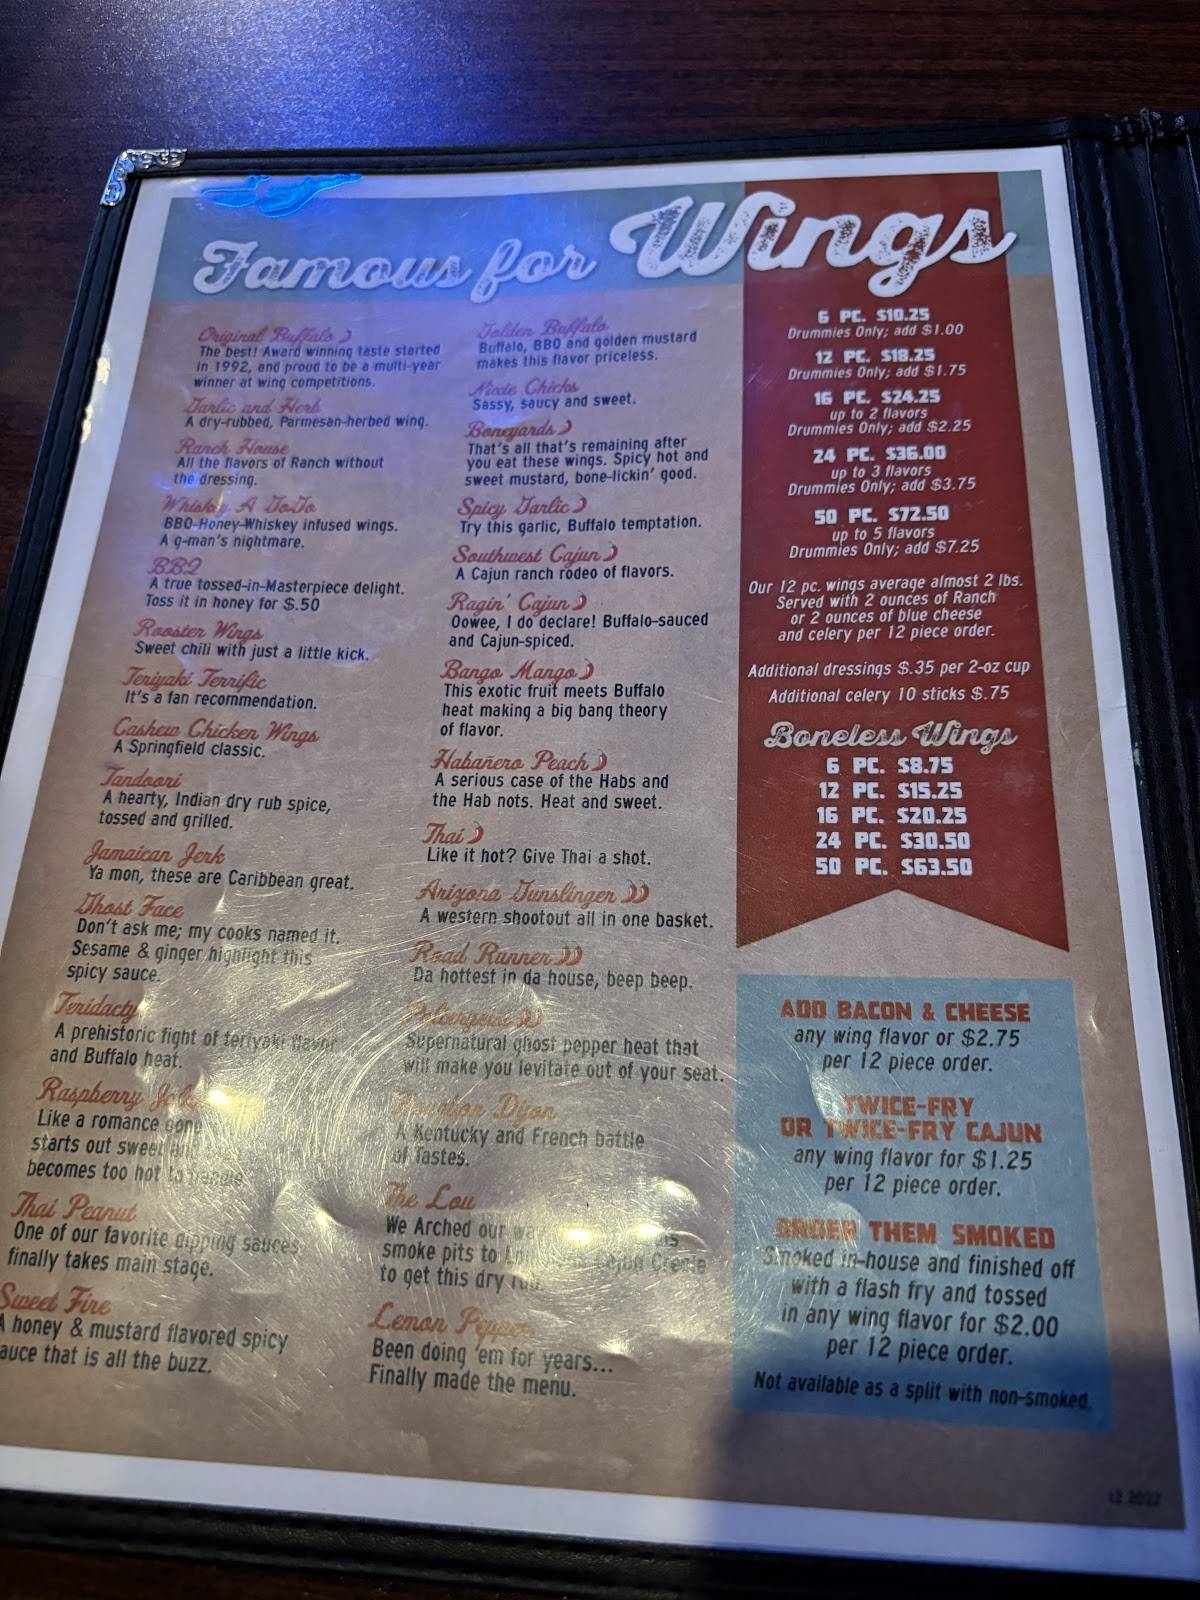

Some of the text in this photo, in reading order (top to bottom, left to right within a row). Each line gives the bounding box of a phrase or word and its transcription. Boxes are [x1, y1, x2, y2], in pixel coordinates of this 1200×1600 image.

[193, 190, 1016, 303] Famous for Wings
[817, 308, 930, 324] 6 PC. $10.25
[787, 324, 964, 340] Drummies Only; add $1.00
[815, 348, 935, 364] 12 PC. $18.25
[787, 364, 967, 382] Drummies Only; add $1.75
[814, 390, 940, 405] 16 PC. $24.25
[184, 415, 427, 432] A dry-rubbed, Parmesan-herbed wing.
[829, 407, 928, 423] up to 2 flavors
[787, 420, 972, 438] Drummies Only; add $2.25
[812, 446, 946, 464] 24 PC. $36.00
[830, 465, 932, 482] up to 3 flavors
[814, 506, 949, 525] 50 PC. $72.50
[460, 516, 701, 536] Try this garlic, Buffalo temptation.
[453, 544, 600, 567] Southwest Cajun
[455, 564, 673, 584] A Cajun ranch rodeo of flavors.
[747, 575, 1022, 597] Our 12 pc. wings average almost 2 lbs.
[775, 591, 997, 610] Served with 2 ounces of Ranch
[133, 642, 368, 662] Sweet chili with just a little kick.
[121, 666, 266, 694] Teriyaki Terrific
[440, 659, 577, 684] Bango Mango
[747, 660, 1030, 681] Additional dressings $.35 per 2-oz cup
[444, 683, 665, 697] This exotic fruit meets Buffalo
[124, 691, 316, 710] It's a fan recommendation.
[113, 717, 320, 746] Cashew Chicken Wings
[764, 720, 1018, 754] Boneless Wings
[113, 740, 264, 759] A Springfield classic.
[531, 750, 589, 771] Peach
[826, 757, 953, 774] 6 PC. $8.75
[819, 782, 962, 799] 12 PC. $15.25
[816, 807, 967, 824] 16 PC. $20.25
[815, 832, 970, 850] 24 PC. $30.50
[427, 847, 651, 865] Like it hot? Give Thai a shot.
[815, 857, 972, 876] 50 PC. $63.50
[780, 1000, 1030, 1023] ADD BACON & CHEESE
[793, 1027, 1020, 1049] any wing flavor or $2.75
[822, 1052, 992, 1076] per 12 piece order.
[369, 1364, 576, 1397] Finally made the menu.
[753, 1371, 782, 1390] Not
[787, 1373, 859, 1395] available
[864, 1382, 883, 1396] as
[889, 1383, 899, 1397] a
[905, 1380, 941, 1404] split
[948, 1383, 982, 1402] with
